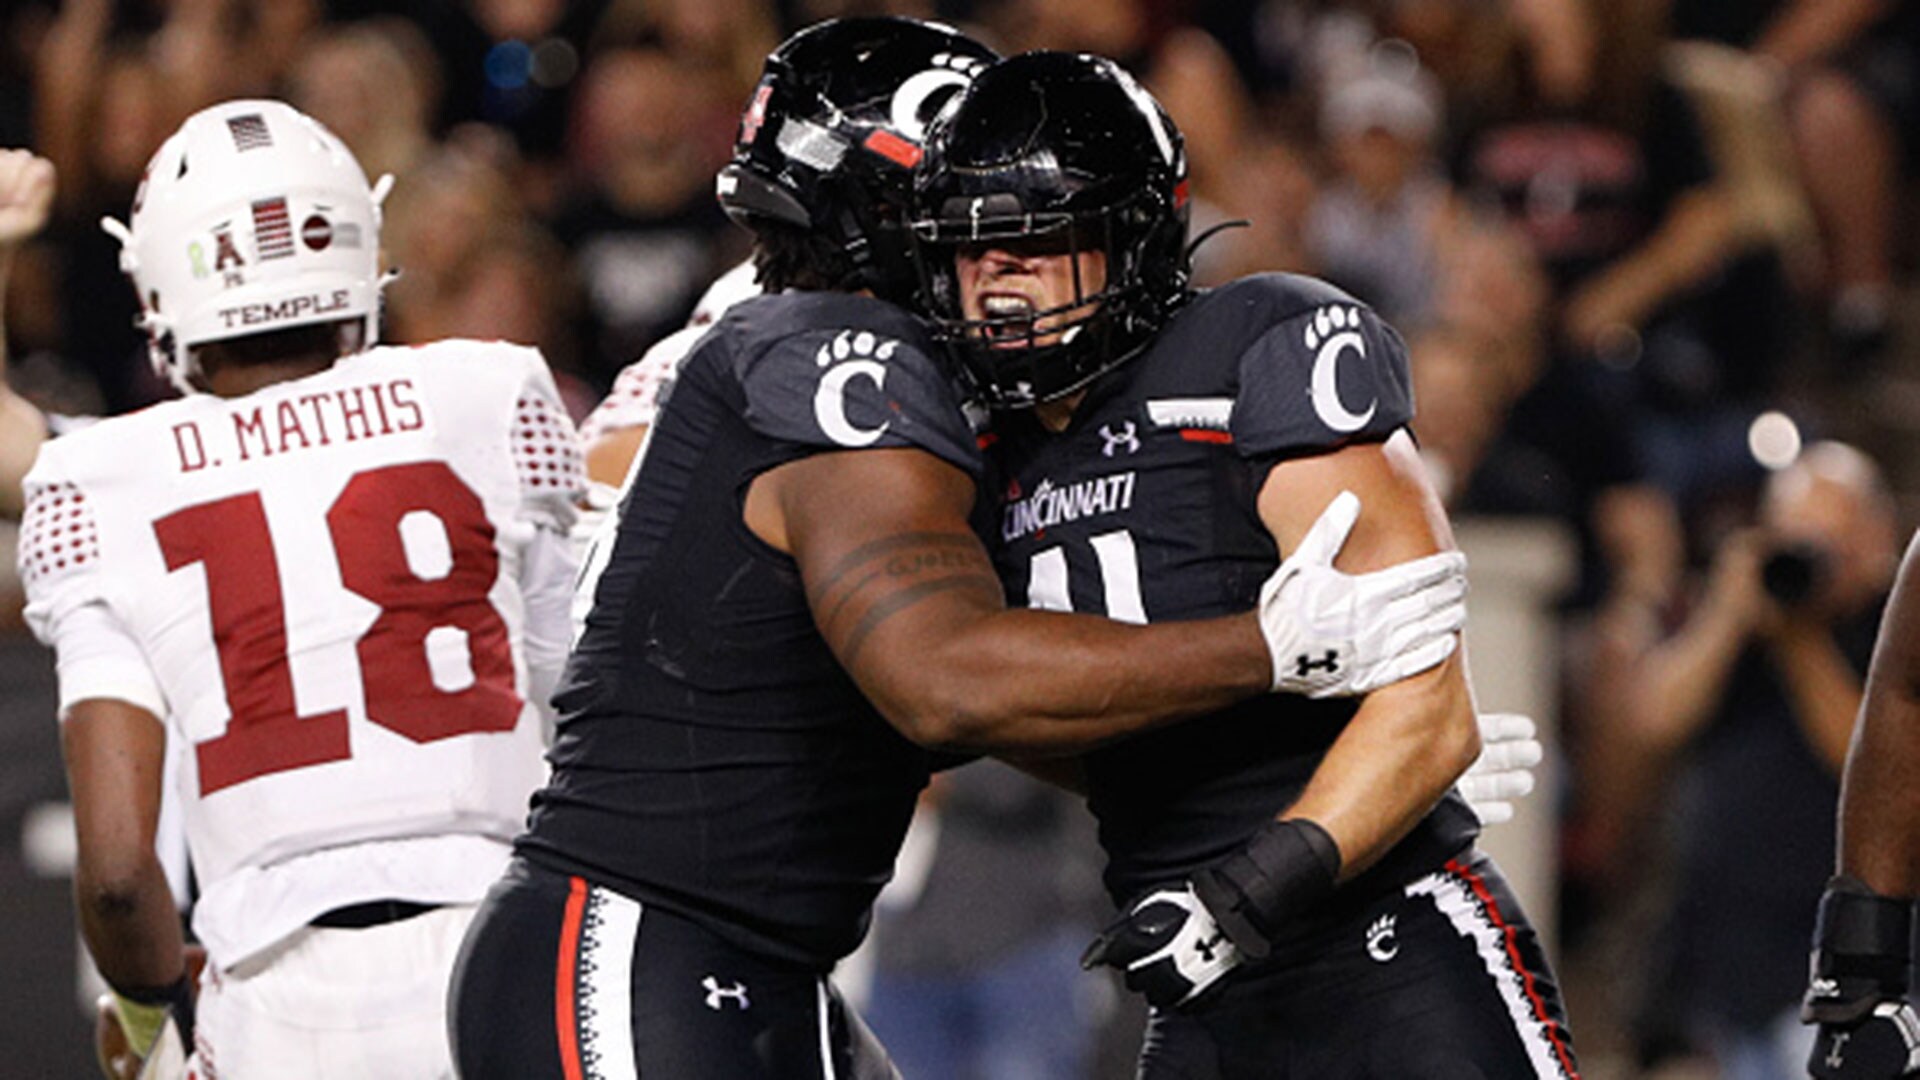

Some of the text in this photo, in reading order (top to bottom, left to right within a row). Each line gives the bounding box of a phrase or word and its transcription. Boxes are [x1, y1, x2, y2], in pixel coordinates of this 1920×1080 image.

[218, 289, 350, 329] TEMPLE
[172, 379, 425, 473] D. MATHIS
[813, 359, 890, 447] C
[1310, 331, 1377, 433] C
[1001, 471, 1136, 542] CINCINNATI
[151, 459, 525, 799] 18
